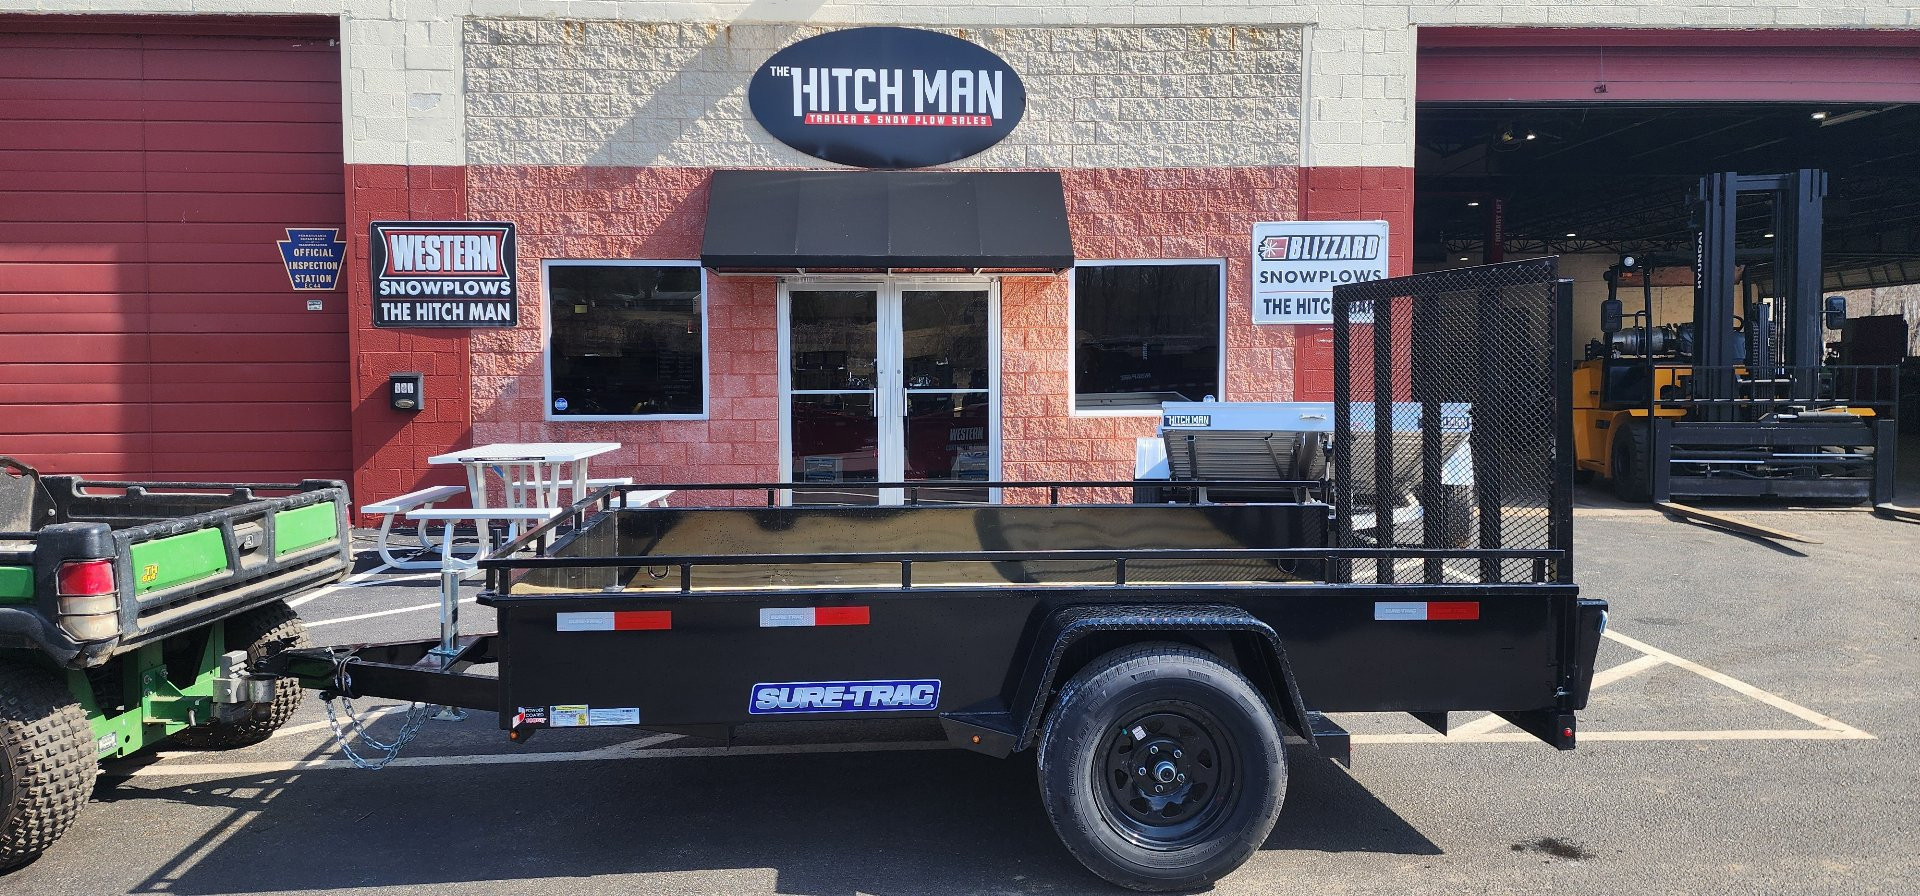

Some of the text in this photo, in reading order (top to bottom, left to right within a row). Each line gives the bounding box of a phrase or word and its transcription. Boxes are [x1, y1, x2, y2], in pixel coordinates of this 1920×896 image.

[770, 66, 1003, 119] THE HITCH MAN
[810, 114, 987, 125] TRAILER & SNOW PLOW SALES
[293, 248, 334, 257] OFFICIAL
[390, 234, 497, 271] WESTERN
[1288, 236, 1379, 260] BLIZZARD
[288, 261, 338, 270] INSPECTION
[295, 274, 332, 283] STATION
[1259, 269, 1381, 284] SNOWPLOWS
[379, 280, 511, 295] SNOWPLOWS
[381, 302, 511, 320] THE HITCH MAN
[1263, 298, 1292, 315] THE
[1296, 297, 1334, 315] HITC
[950, 426, 984, 441] WESTERN
[756, 684, 935, 709] SURE-TRAC
